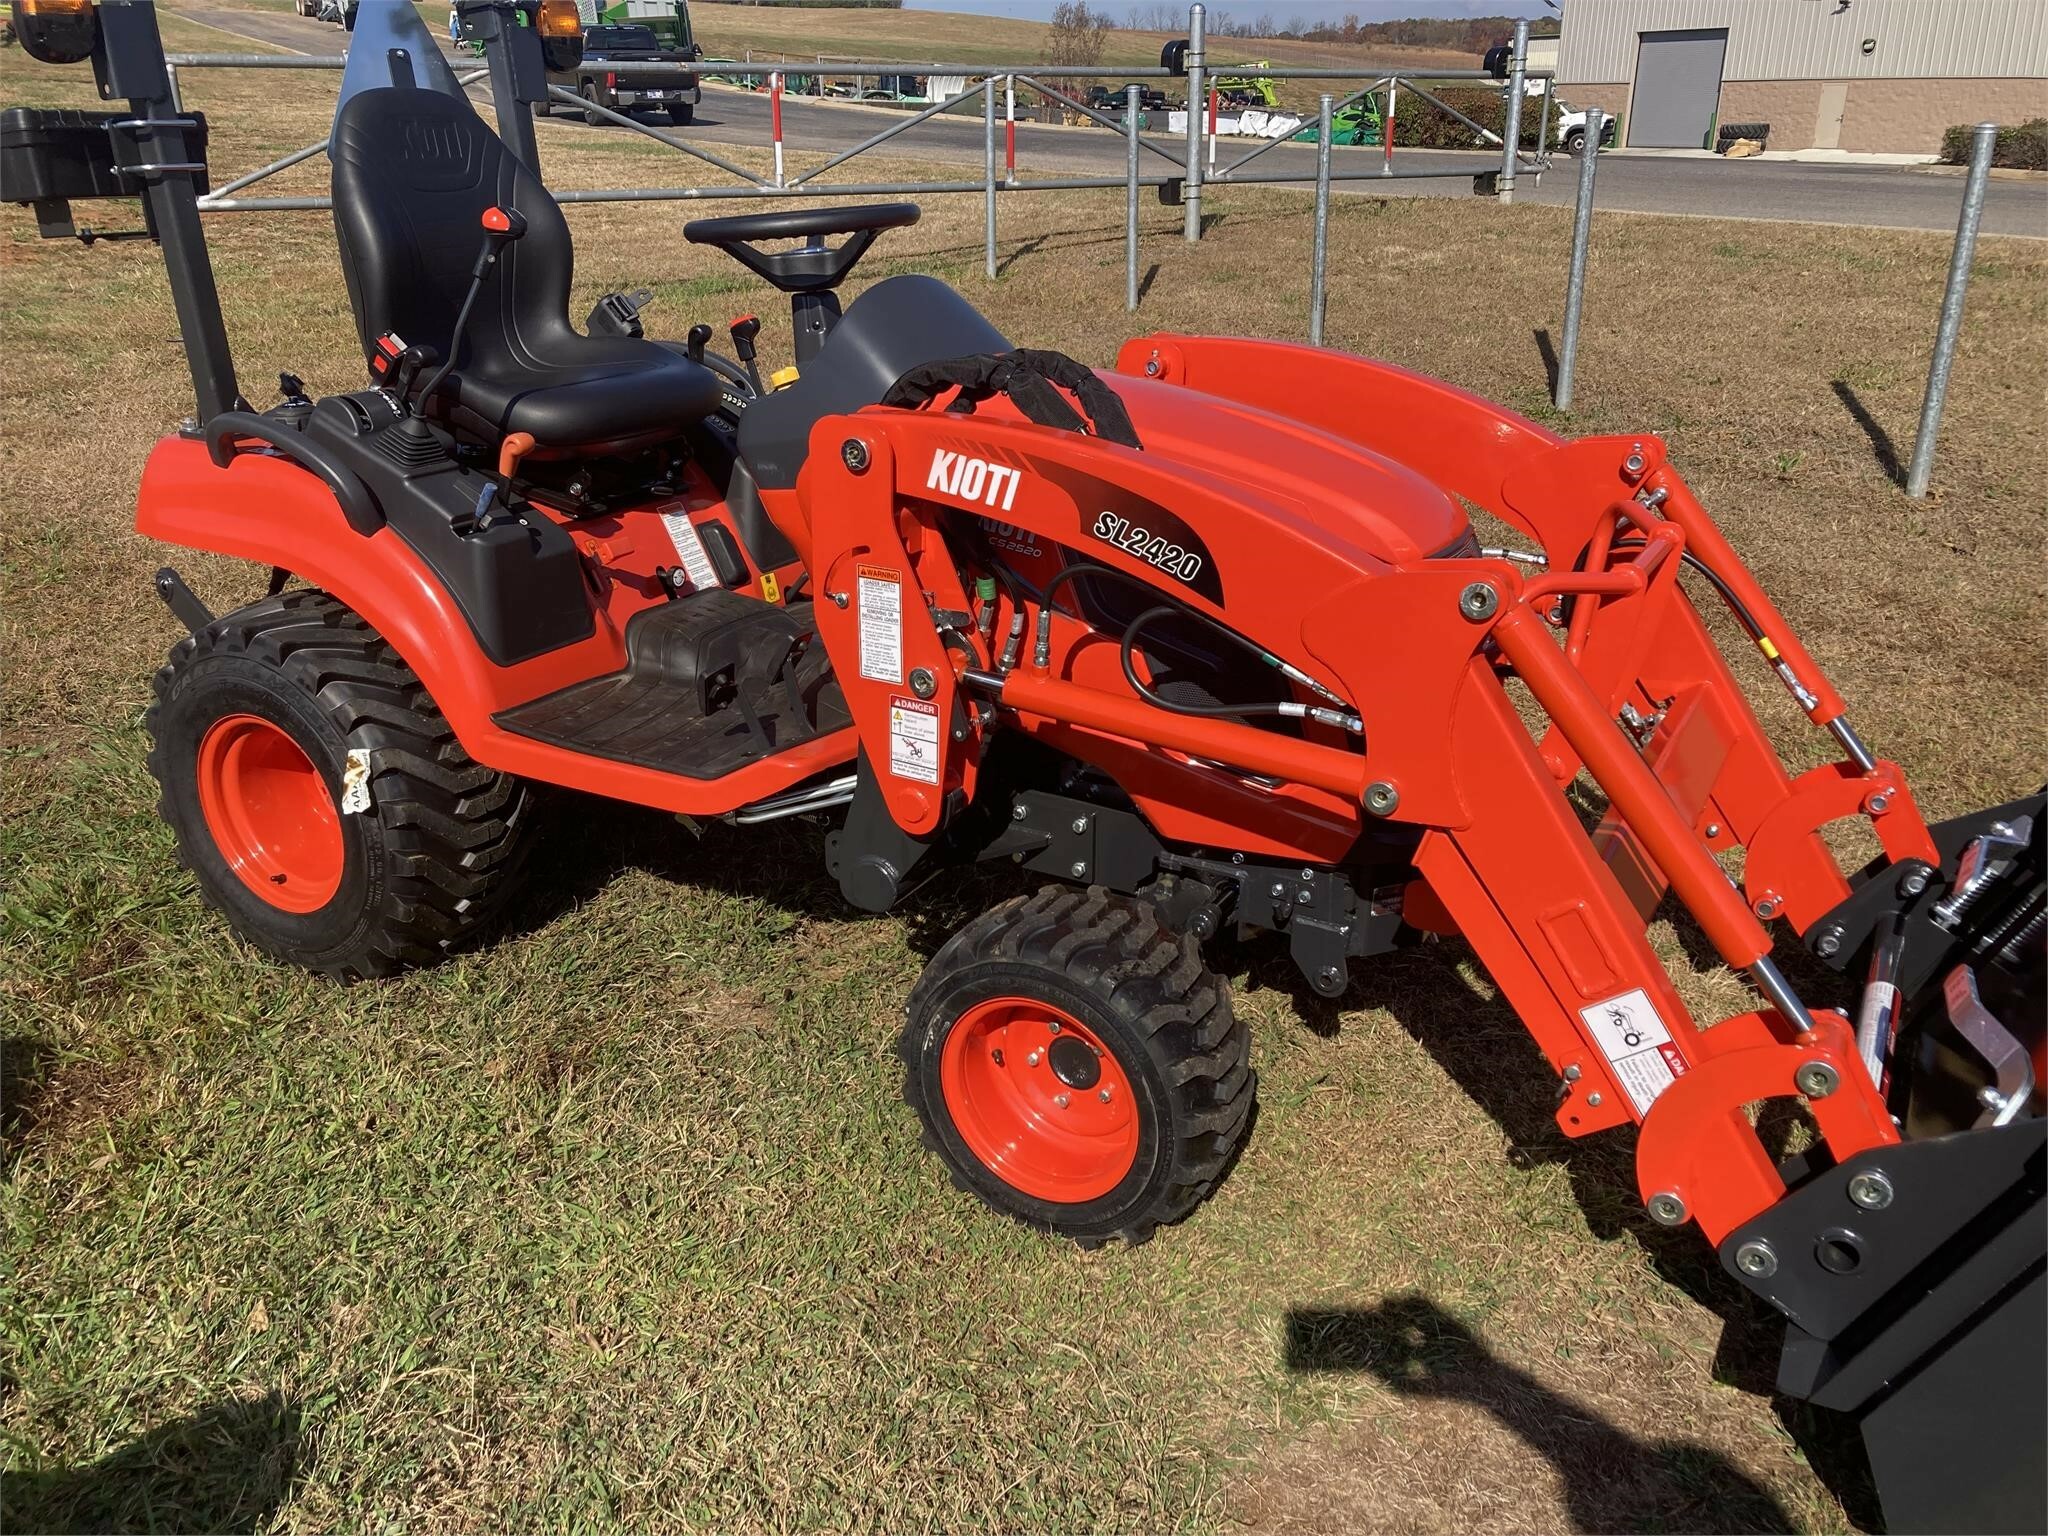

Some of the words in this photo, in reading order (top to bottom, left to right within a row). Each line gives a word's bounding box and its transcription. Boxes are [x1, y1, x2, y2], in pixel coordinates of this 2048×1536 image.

[927, 448, 1021, 511] KIOTI
[989, 537, 1043, 557] CS2520
[1093, 511, 1202, 581] SL2420
[867, 569, 898, 580] WARNING
[902, 700, 935, 714] DANGER
